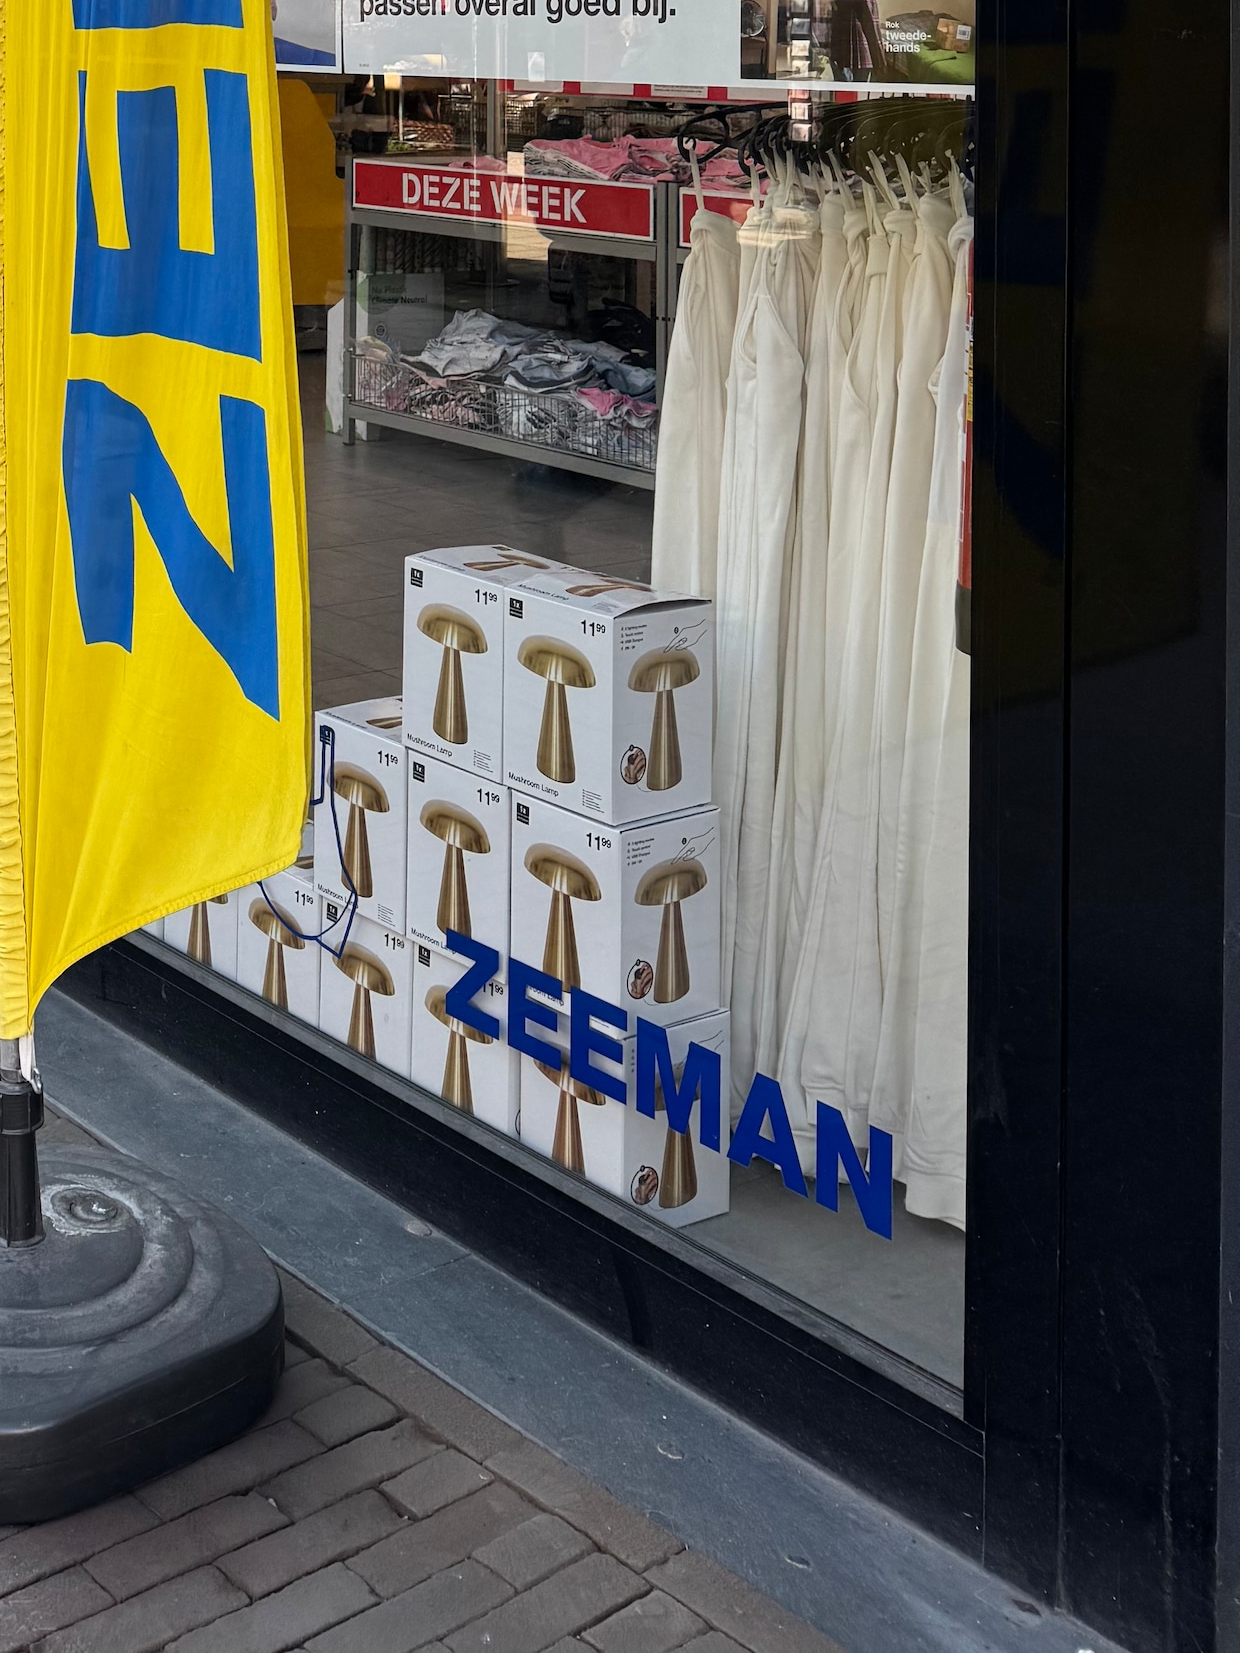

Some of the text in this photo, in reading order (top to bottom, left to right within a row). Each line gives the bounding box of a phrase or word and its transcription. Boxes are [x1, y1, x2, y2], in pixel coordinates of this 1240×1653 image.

[885, 30, 931, 40] tweede-
[885, 42, 920, 53] hands
[402, 171, 588, 224] DEZE WEEK
[475, 589, 498, 606] 1199
[580, 620, 606, 637] 1199
[407, 732, 453, 758] Mushroom Lamp
[377, 750, 399, 767] 1199
[508, 771, 560, 798] Mushroom Lamp
[477, 788, 500, 806] 1199
[586, 832, 612, 851] 1199
[294, 890, 314, 906] 1199
[317, 883, 344, 902] Mushroom
[384, 933, 405, 951] 1199
[411, 926, 440, 946] Mushroom
[445, 927, 893, 1241] ZEEMAN
